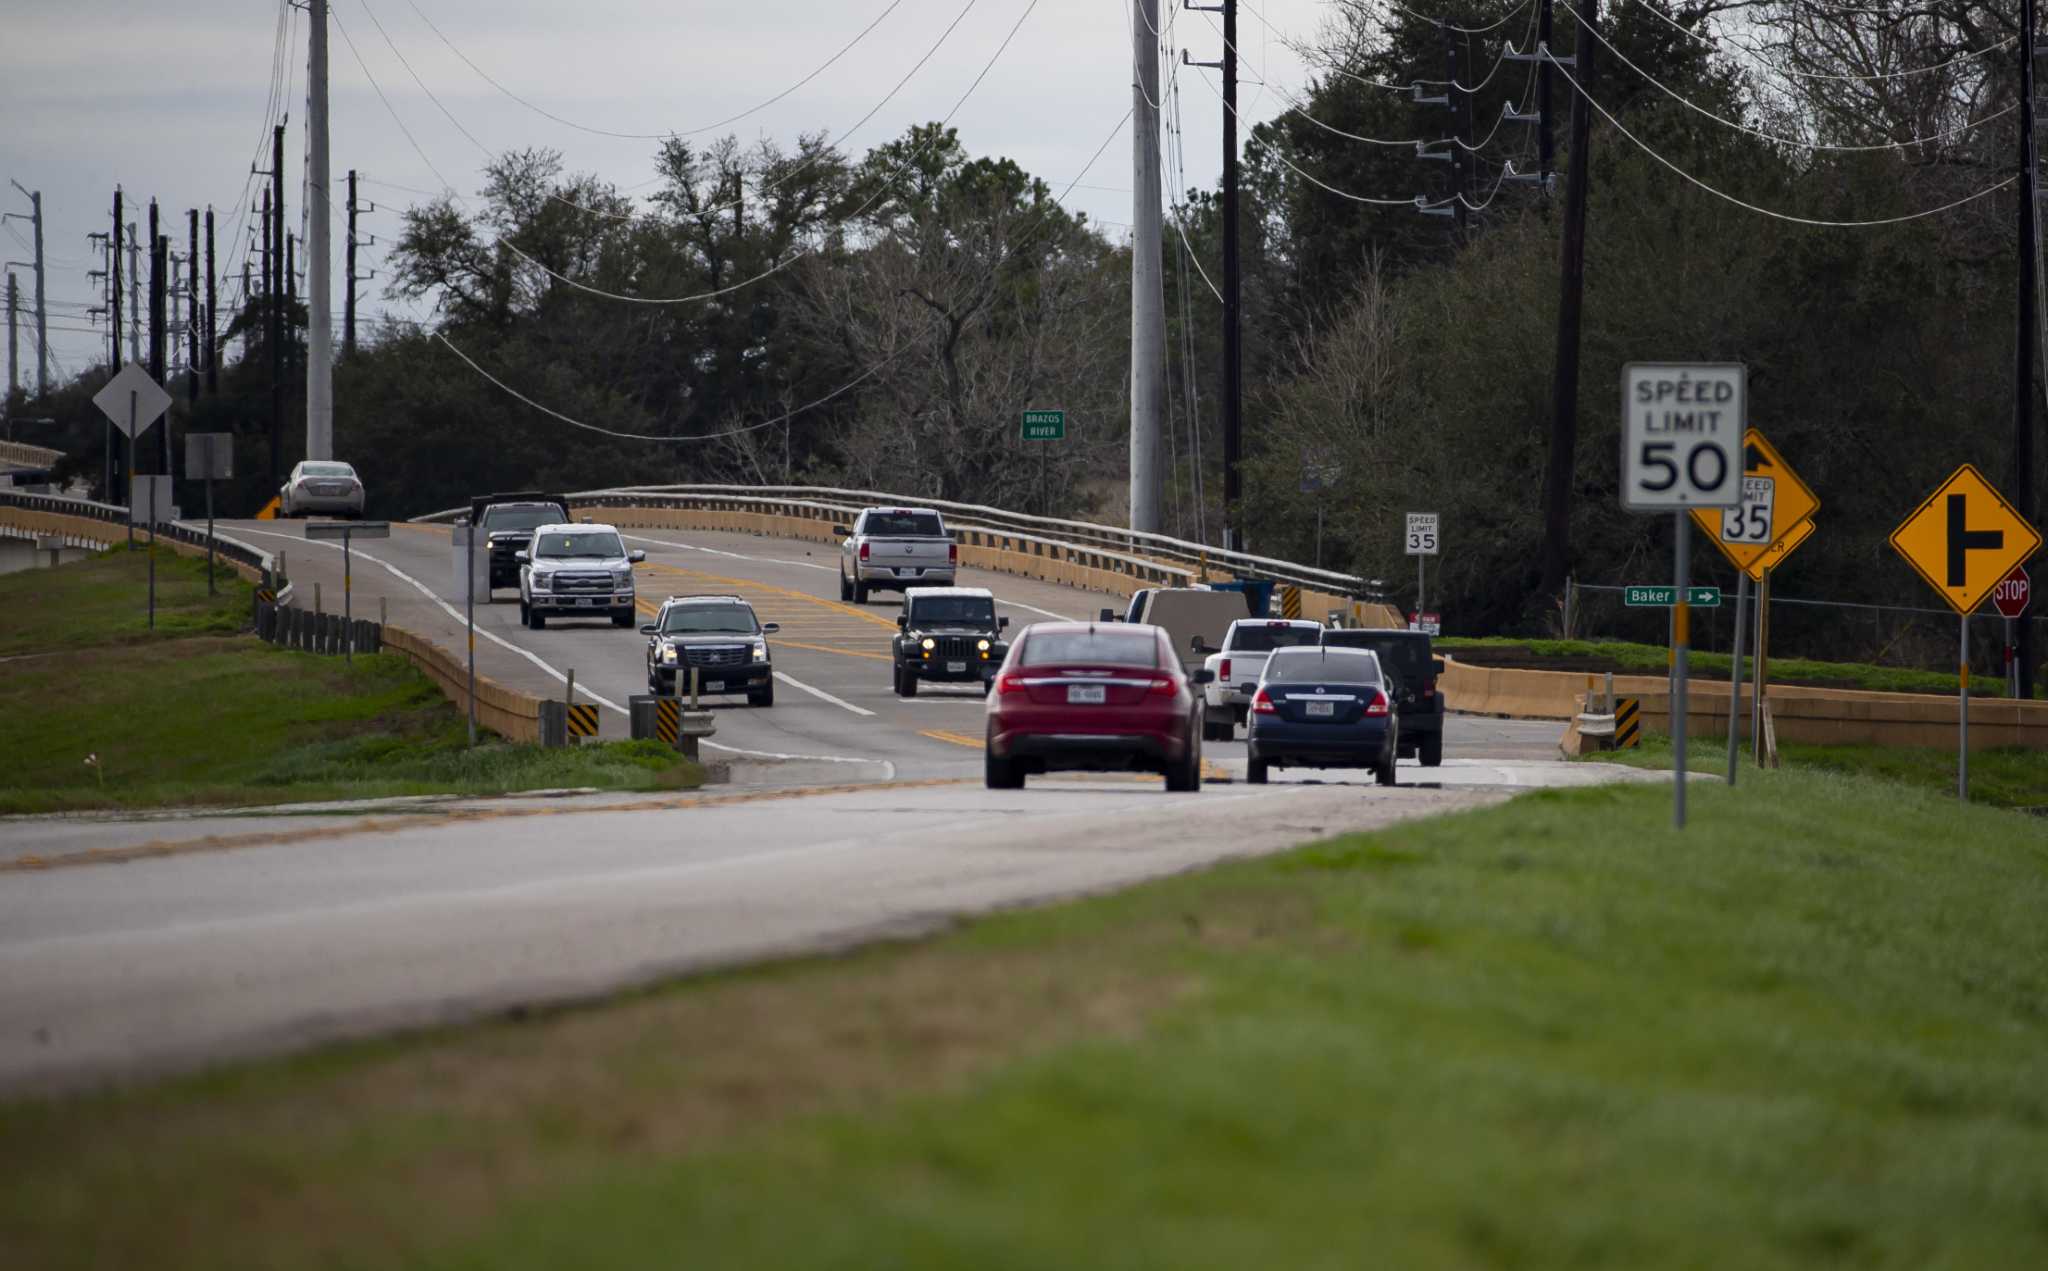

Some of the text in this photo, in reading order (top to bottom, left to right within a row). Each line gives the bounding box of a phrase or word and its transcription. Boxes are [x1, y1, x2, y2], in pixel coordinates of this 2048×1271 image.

[1636, 380, 1733, 403] SPEED
[1026, 414, 1060, 424] BRAZOS
[1645, 411, 1721, 433] LIMIT
[1030, 427, 1056, 436] RIVER
[1639, 441, 1728, 492] 50
[1409, 516, 1435, 524] SPEED
[1726, 504, 1768, 539] 35
[1411, 525, 1432, 533] LIMIT
[1409, 534, 1435, 549] 35
[1632, 590, 1670, 602] Baker
[1996, 580, 2028, 600] STOP
